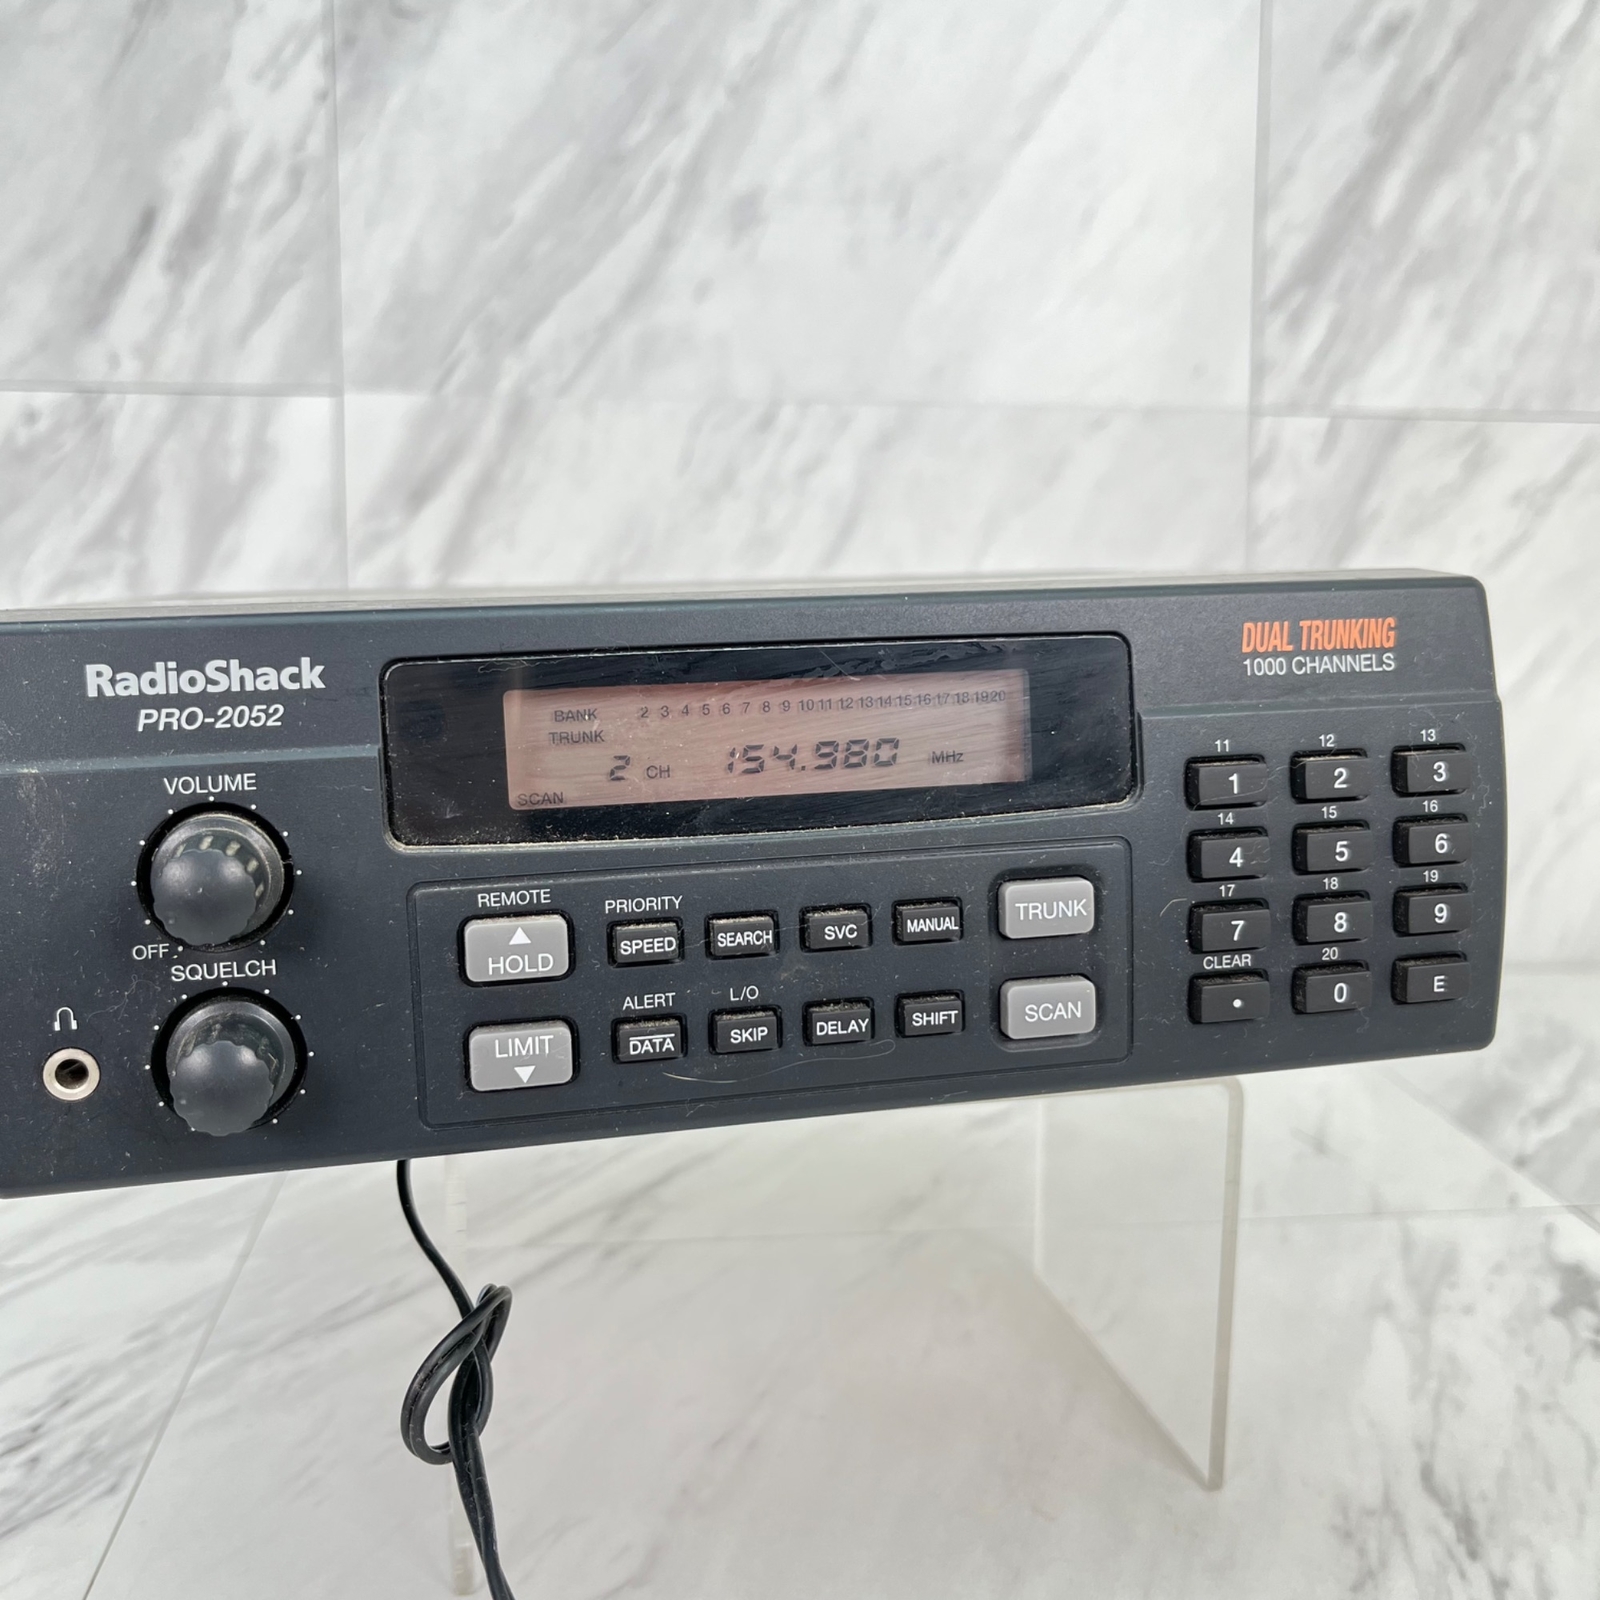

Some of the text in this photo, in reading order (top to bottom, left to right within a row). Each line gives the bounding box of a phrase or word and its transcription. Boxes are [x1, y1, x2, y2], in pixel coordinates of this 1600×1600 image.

[1242, 618, 1395, 653] DUAL TRUNKING
[1243, 654, 1395, 676] 1000 CHANNELS
[86, 658, 325, 698] RadioShack
[554, 691, 1005, 722] BANK 2 3 4 5 6 7 8 9 10 11 12 13 14 15 16 17 18 19 20
[138, 704, 284, 732] PRO-2052
[548, 730, 604, 744] TRUNK
[1319, 735, 1334, 747] 12
[1420, 730, 1436, 742] 13
[1215, 740, 1229, 752] 11
[610, 738, 964, 781] 2 CH 154.980 MHz
[1334, 768, 1347, 788] 2
[1433, 763, 1446, 782] 3
[164, 774, 257, 795] VOLUME
[1229, 774, 1239, 794] 1
[518, 792, 563, 807] SCAN
[1423, 801, 1438, 812] 16
[1218, 813, 1234, 825] 14
[1322, 807, 1337, 818] 15
[1335, 842, 1348, 862] 5
[1435, 834, 1448, 853] 6
[1229, 847, 1243, 867] 4
[1323, 878, 1339, 890] 18
[1423, 871, 1438, 882] 19
[477, 890, 551, 907] REMOTE
[1219, 885, 1235, 897] 17
[605, 895, 683, 915] PRIORITY
[1015, 899, 1087, 921] TRUNK
[1434, 904, 1447, 923] 9
[824, 924, 857, 941] SVC
[907, 914, 958, 933] MANUAL
[1231, 921, 1245, 941] 7
[1334, 913, 1347, 933] 8
[620, 937, 676, 955] SPEED
[717, 929, 772, 948] SEARCH
[132, 945, 169, 960] OFF
[1203, 954, 1251, 970] CLEAR
[1322, 948, 1338, 960] 20
[171, 960, 276, 982] SQUELCH
[488, 954, 554, 975] HOLD
[730, 986, 759, 1001] L/O
[1334, 982, 1347, 1002] 0
[1434, 976, 1444, 992] E
[622, 993, 676, 1010] ALERT
[1024, 1000, 1081, 1022] SCAN
[816, 1018, 869, 1036] DELAY
[912, 1009, 958, 1027] SHIFT
[730, 1026, 768, 1044] SKIP
[495, 1035, 554, 1058] LIMIT
[629, 1036, 674, 1055] DATA
